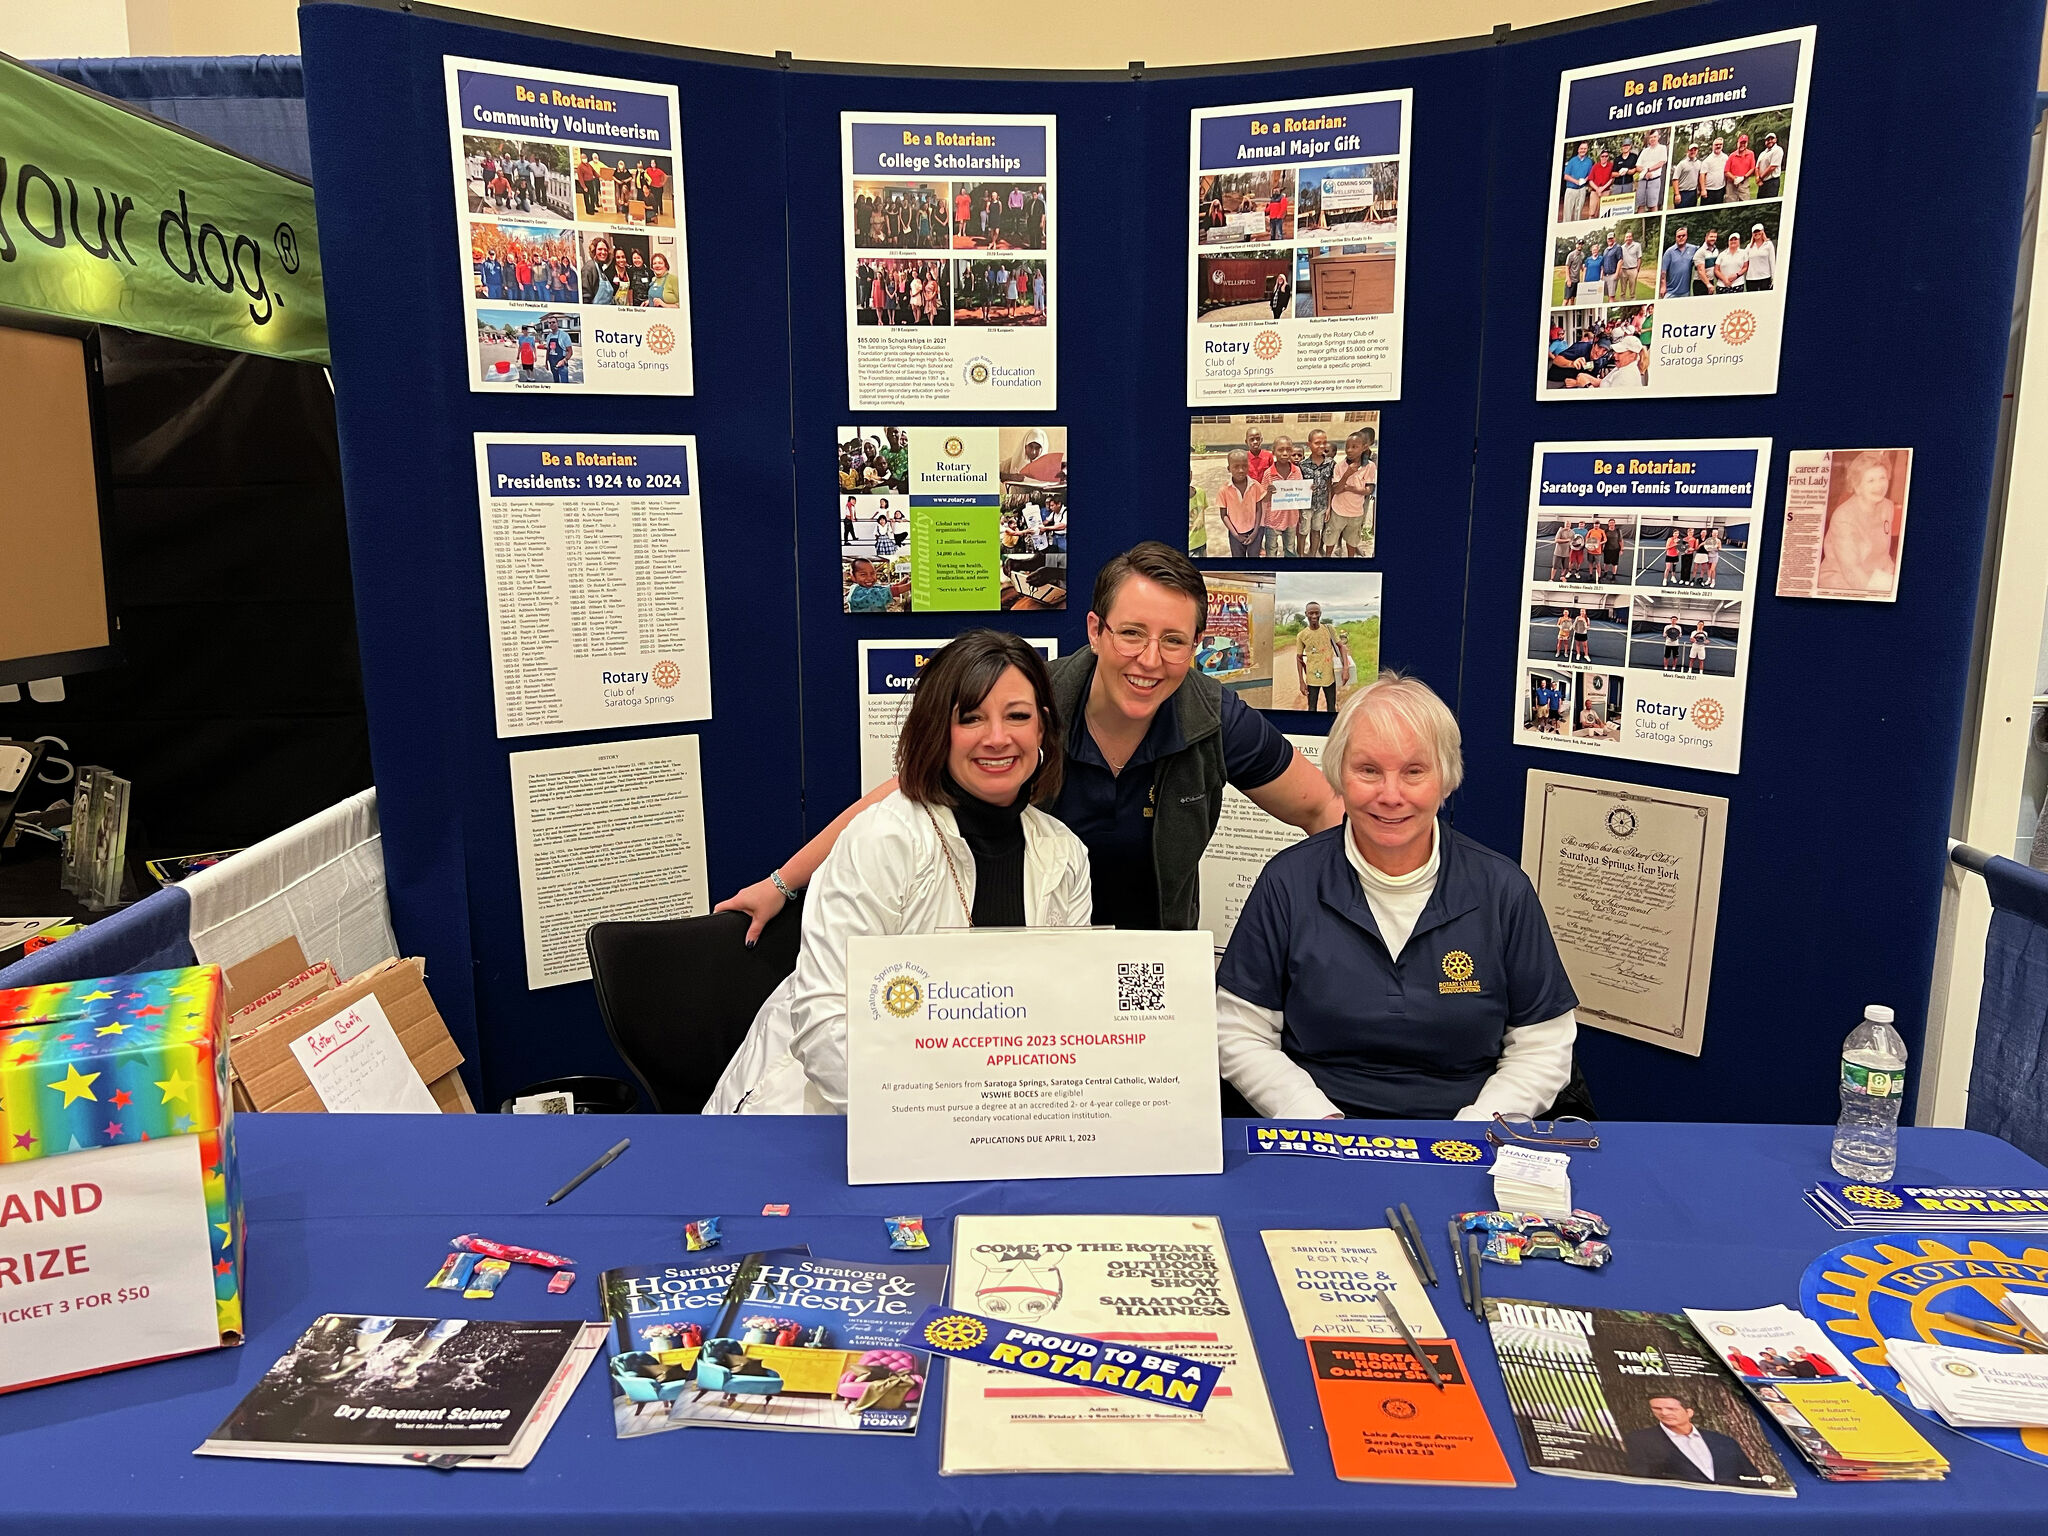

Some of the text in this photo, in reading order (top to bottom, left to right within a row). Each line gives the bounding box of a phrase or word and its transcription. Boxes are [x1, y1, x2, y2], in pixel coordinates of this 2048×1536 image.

[1624, 66, 1735, 97] Be a Rotarian:
[516, 84, 617, 112] Be a Rotarian:
[1608, 85, 1747, 120] Fall Golf Tournament
[473, 104, 660, 141] Community Volunteerism
[1251, 114, 1347, 136] Be a Rotarian:
[903, 131, 996, 147] Be a Rotarian:
[1237, 133, 1361, 160] Annual Major Gift
[878, 152, 1021, 172] College Scholarships
[595, 329, 643, 347] Rotary
[1661, 321, 1717, 340] Rotary
[596, 348, 629, 359] Club of
[1204, 340, 1250, 355] Rotary
[597, 358, 670, 372] Saratoga Springs
[991, 366, 1035, 377] Education
[991, 377, 1042, 388] Foundation
[541, 451, 638, 467] Be a Rotarian:
[1823, 452, 1830, 461] A
[936, 461, 972, 474] Rotary
[1594, 459, 1696, 476] Be a Rotarian:
[497, 473, 682, 490] Presidents: 1924 to 2024
[921, 472, 988, 483] International
[1788, 476, 1828, 487] First Lady
[1542, 479, 1752, 497] Saratoga Open Tennis Tournament
[913, 512, 932, 608] Humanity
[602, 670, 649, 685] Rotary
[603, 686, 635, 698] Club of
[604, 694, 675, 708] Saratoga Springs
[1636, 699, 1687, 720] Rotary
[1559, 848, 1599, 865] Saratoga
[1637, 861, 1656, 875] New
[1657, 865, 1679, 880] York
[927, 981, 1014, 1001] Education
[927, 1003, 1028, 1021] Foundation
[307, 1008, 363, 1057] Rotary Booth
[914, 1032, 1147, 1050] NOW ACCEPTING 2023 SCHOLARSHIP
[986, 1052, 1077, 1067] APPLICATIONS
[980, 1089, 1013, 1100] WSWHE
[1013, 1089, 1039, 1099] BOCES
[1040, 1089, 1053, 1099] are
[969, 1135, 1025, 1146] APPLICATIONS
[1026, 1134, 1044, 1145] DUE
[1044, 1133, 1067, 1144] APRIL
[1077, 1132, 1097, 1144] 2023
[1256, 1127, 1417, 1150] ROTARIAN
[1259, 1139, 1420, 1161] PROUD TO BE A
[1903, 1186, 1986, 1200] PROUD
[1985, 1188, 2021, 1199] TO
[1915, 1197, 2048, 1213] ROTARI
[975, 1242, 1214, 1255] COME TO THE ROTARY
[1290, 1246, 1378, 1255] SARATOGA SPRINGS
[1149, 1252, 1218, 1263] HOME
[1306, 1255, 1370, 1265] ROTARY
[799, 1260, 888, 1282] Saratoga
[1106, 1260, 1219, 1271] OUTDOOR
[752, 1264, 917, 1298] Home &
[1106, 1269, 1220, 1280] &ENERGY
[1295, 1267, 1392, 1281] home &
[625, 1274, 737, 1298] Home
[1150, 1278, 1220, 1289] SHOW
[1296, 1279, 1398, 1293] outdoor
[1191, 1288, 1222, 1297] AT
[0, 1284, 150, 1325] ICKET 3 FOR $50
[625, 1290, 729, 1316] Lifes
[741, 1284, 907, 1318] Lifestyle
[1099, 1295, 1230, 1308] SARATOGA
[1115, 1305, 1232, 1317] HARNESS
[1496, 1302, 1596, 1336] ROTARY
[1312, 1323, 1361, 1335] APRIL
[1367, 1323, 1384, 1335] 15
[1004, 1327, 1099, 1358] PROUD
[1104, 1346, 1135, 1365] TO
[1141, 1352, 1181, 1374] BE
[1182, 1365, 1203, 1382] A
[1331, 1350, 1440, 1365] THE ROTAY
[1613, 1349, 1662, 1363] TIME
[989, 1340, 1201, 1404] ROTARIAN
[1328, 1366, 1403, 1380] Outdoor
[1354, 1360, 1410, 1371] HOME
[1617, 1363, 1672, 1377] HEAL
[333, 1404, 512, 1422] Dry Basement Science
[862, 1417, 908, 1429] TODAY
